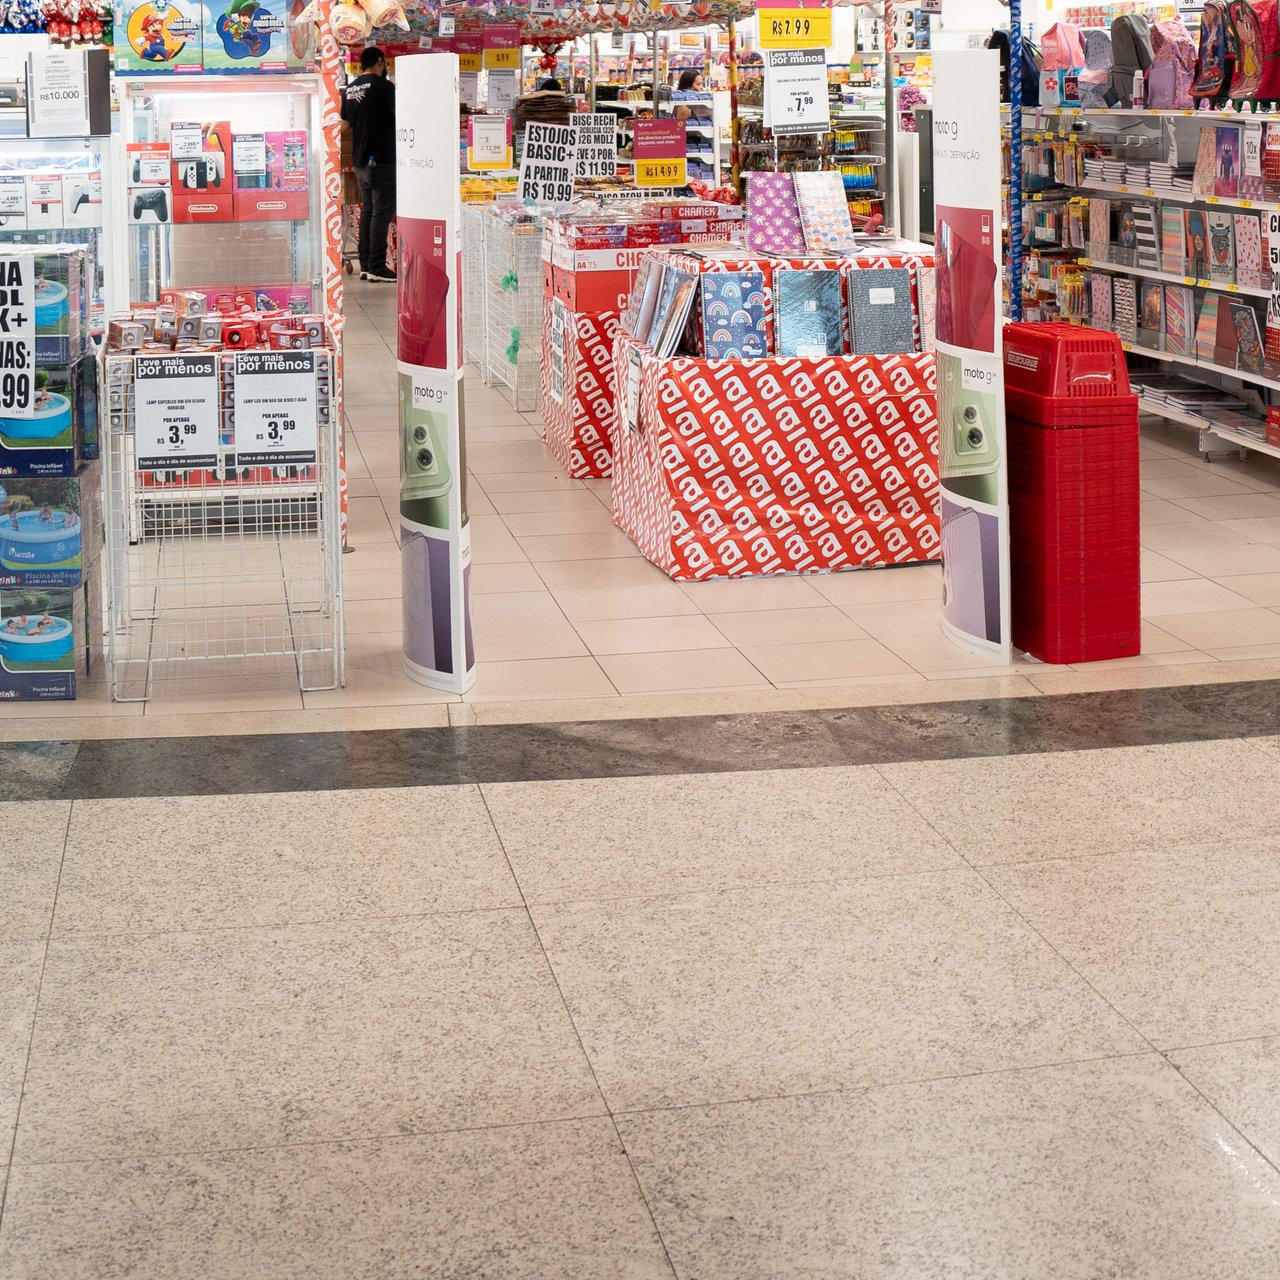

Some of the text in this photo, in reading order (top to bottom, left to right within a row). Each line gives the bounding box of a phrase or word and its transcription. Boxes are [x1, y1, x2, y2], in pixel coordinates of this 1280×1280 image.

[770, 54, 824, 65] por menos
[573, 115, 614, 126] BISC RECH
[528, 124, 576, 146] ESTOJOS
[526, 143, 575, 162] BASIC+
[591, 148, 615, 159] 3 POR:
[950, 150, 980, 160] DEFINIÇÃO
[525, 167, 532, 179] A
[589, 162, 614, 176] 11,99
[523, 182, 572, 202] R$ 19,99
[679, 206, 716, 217] CHAMEX
[710, 222, 747, 232] CHAMEX
[689, 233, 728, 244] CHAMEX
[577, 261, 587, 269] A4
[138, 358, 184, 367] Leve mais
[238, 354, 283, 362] Leve mais
[138, 364, 212, 378] por menos
[238, 359, 311, 373] por menos
[964, 368, 984, 379] moto
[414, 385, 434, 397] moto
